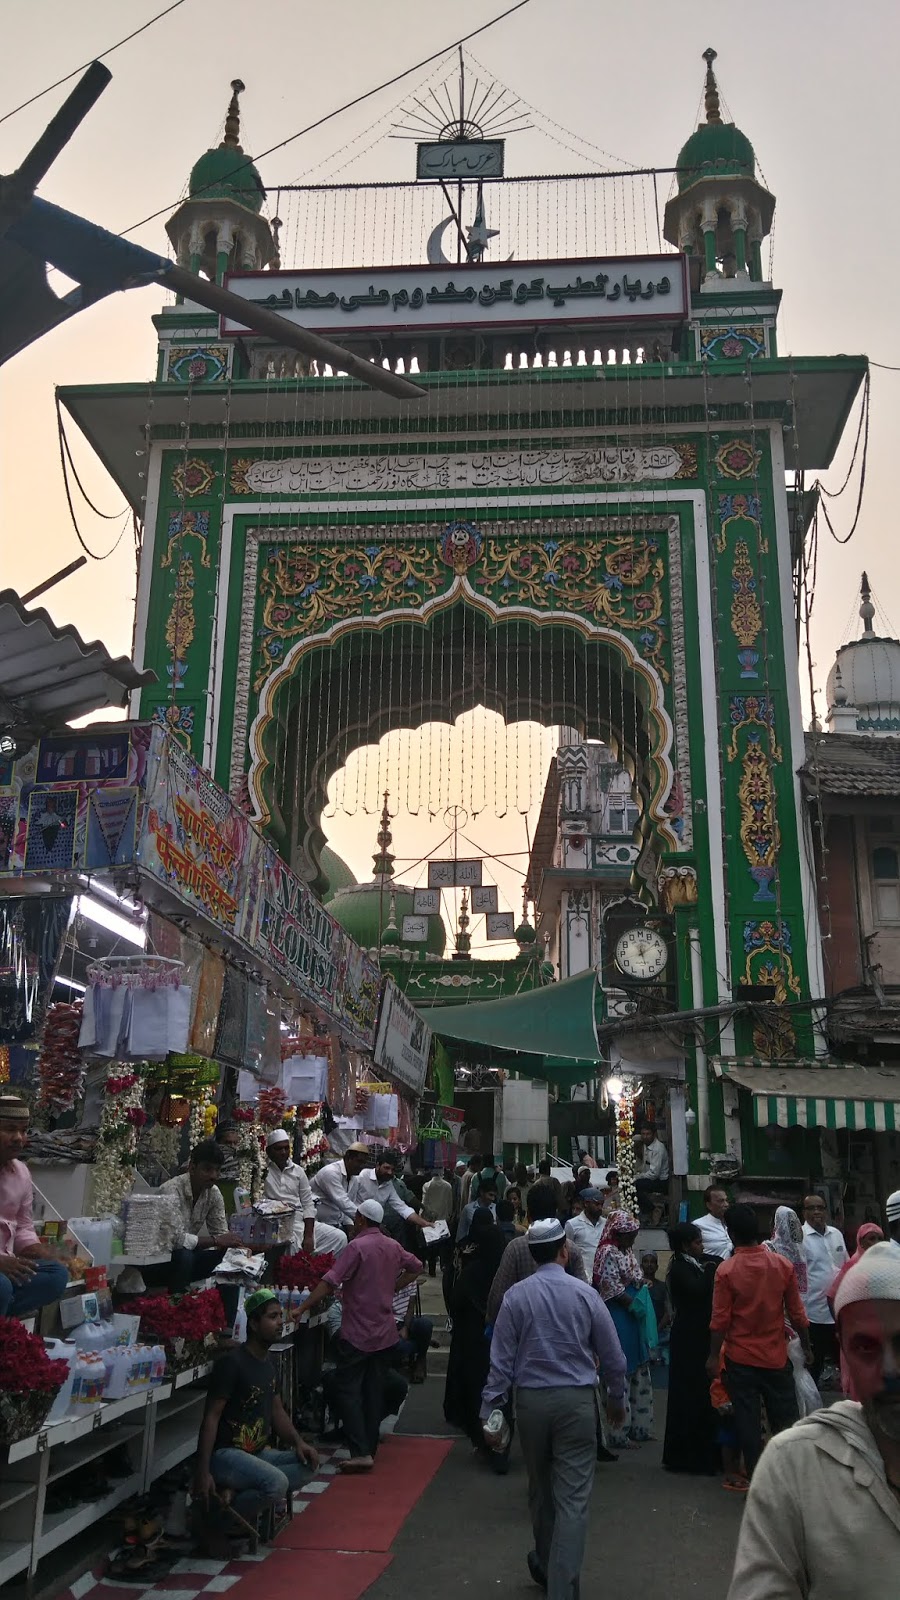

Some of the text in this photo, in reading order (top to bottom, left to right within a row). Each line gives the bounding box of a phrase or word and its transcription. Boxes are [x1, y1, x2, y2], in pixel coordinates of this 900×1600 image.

[467, 152, 495, 171] عرس
[392, 281, 477, 312] مخدوم
[546, 272, 609, 307] قطب
[607, 274, 671, 302] دربار
[276, 867, 333, 954] NASIR
[259, 899, 338, 996] FLORIST
